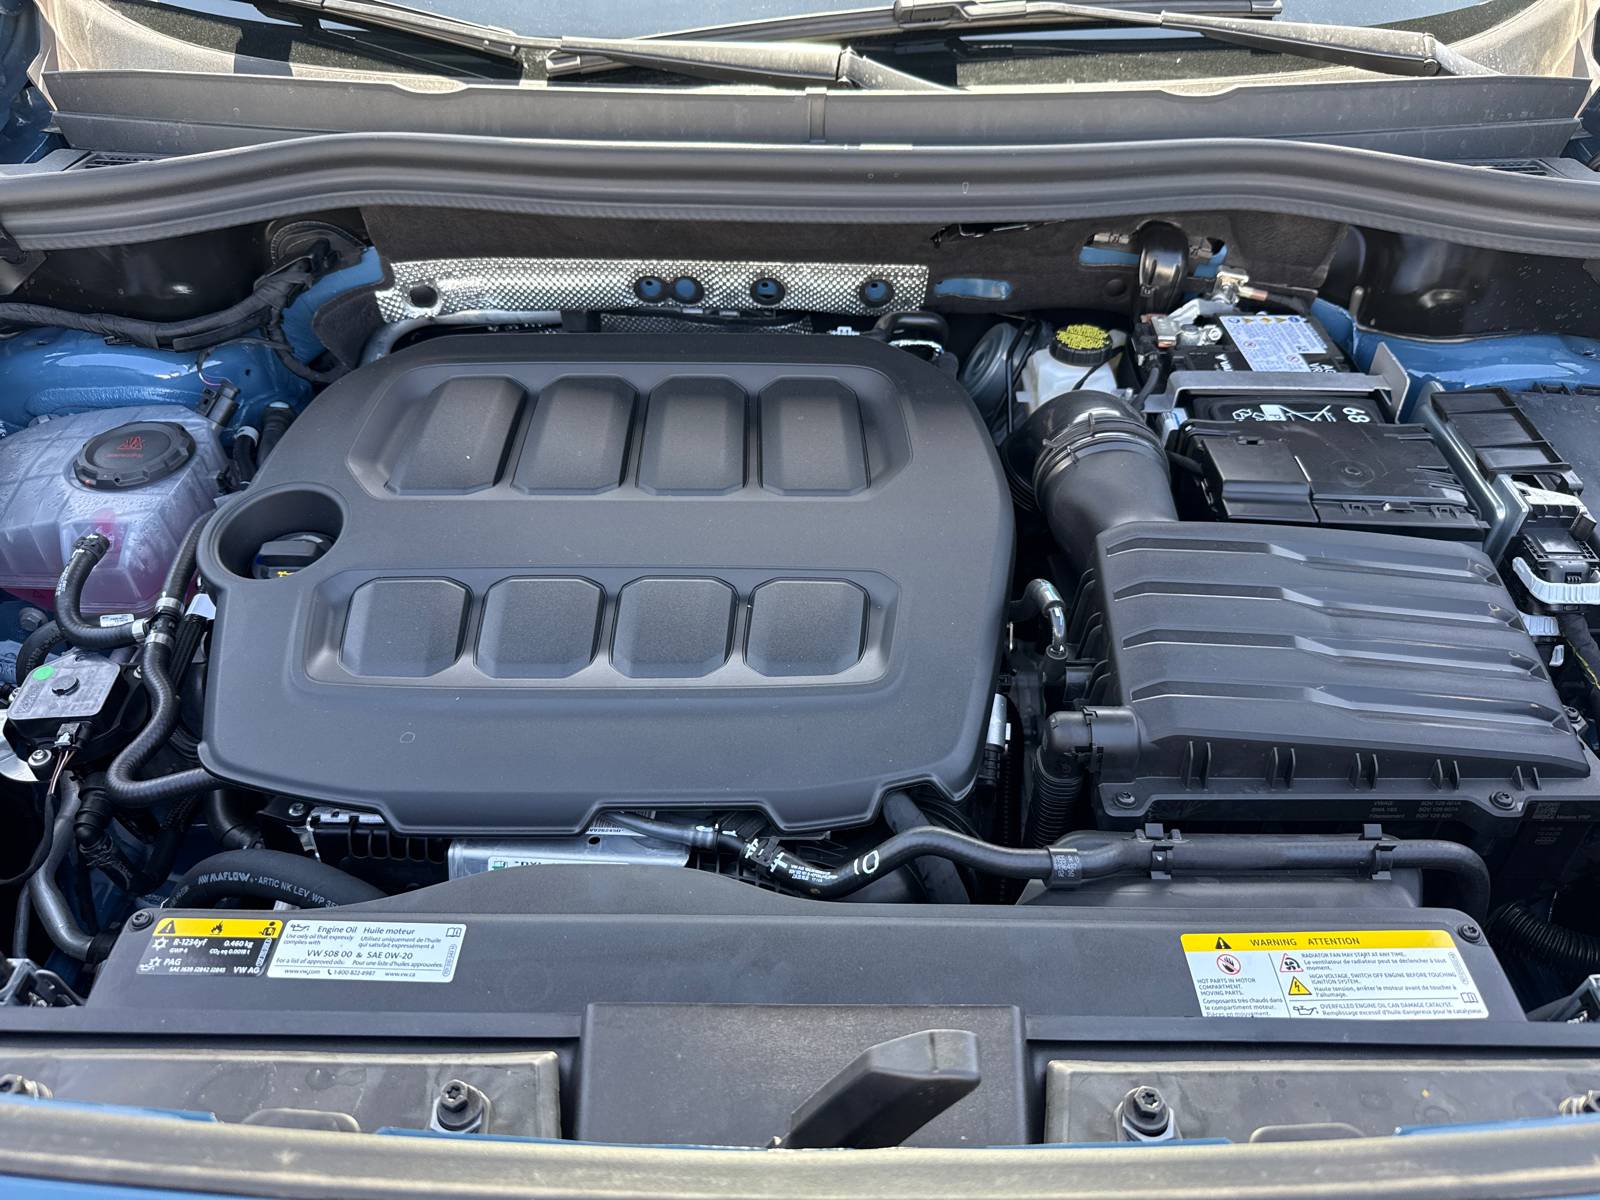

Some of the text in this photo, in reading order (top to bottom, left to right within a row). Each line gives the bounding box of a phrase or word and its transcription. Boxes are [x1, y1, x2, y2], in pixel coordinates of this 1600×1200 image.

[210, 872, 250, 882] MAFLOW
[258, 876, 279, 887] ARTIC
[280, 882, 292, 892] NK
[293, 886, 310, 898] LEV
[312, 893, 325, 904] WP
[318, 926, 344, 934] Engine
[1308, 937, 1360, 945] ATTENTION
[341, 950, 353, 958] 00
[366, 951, 383, 959] SAE
